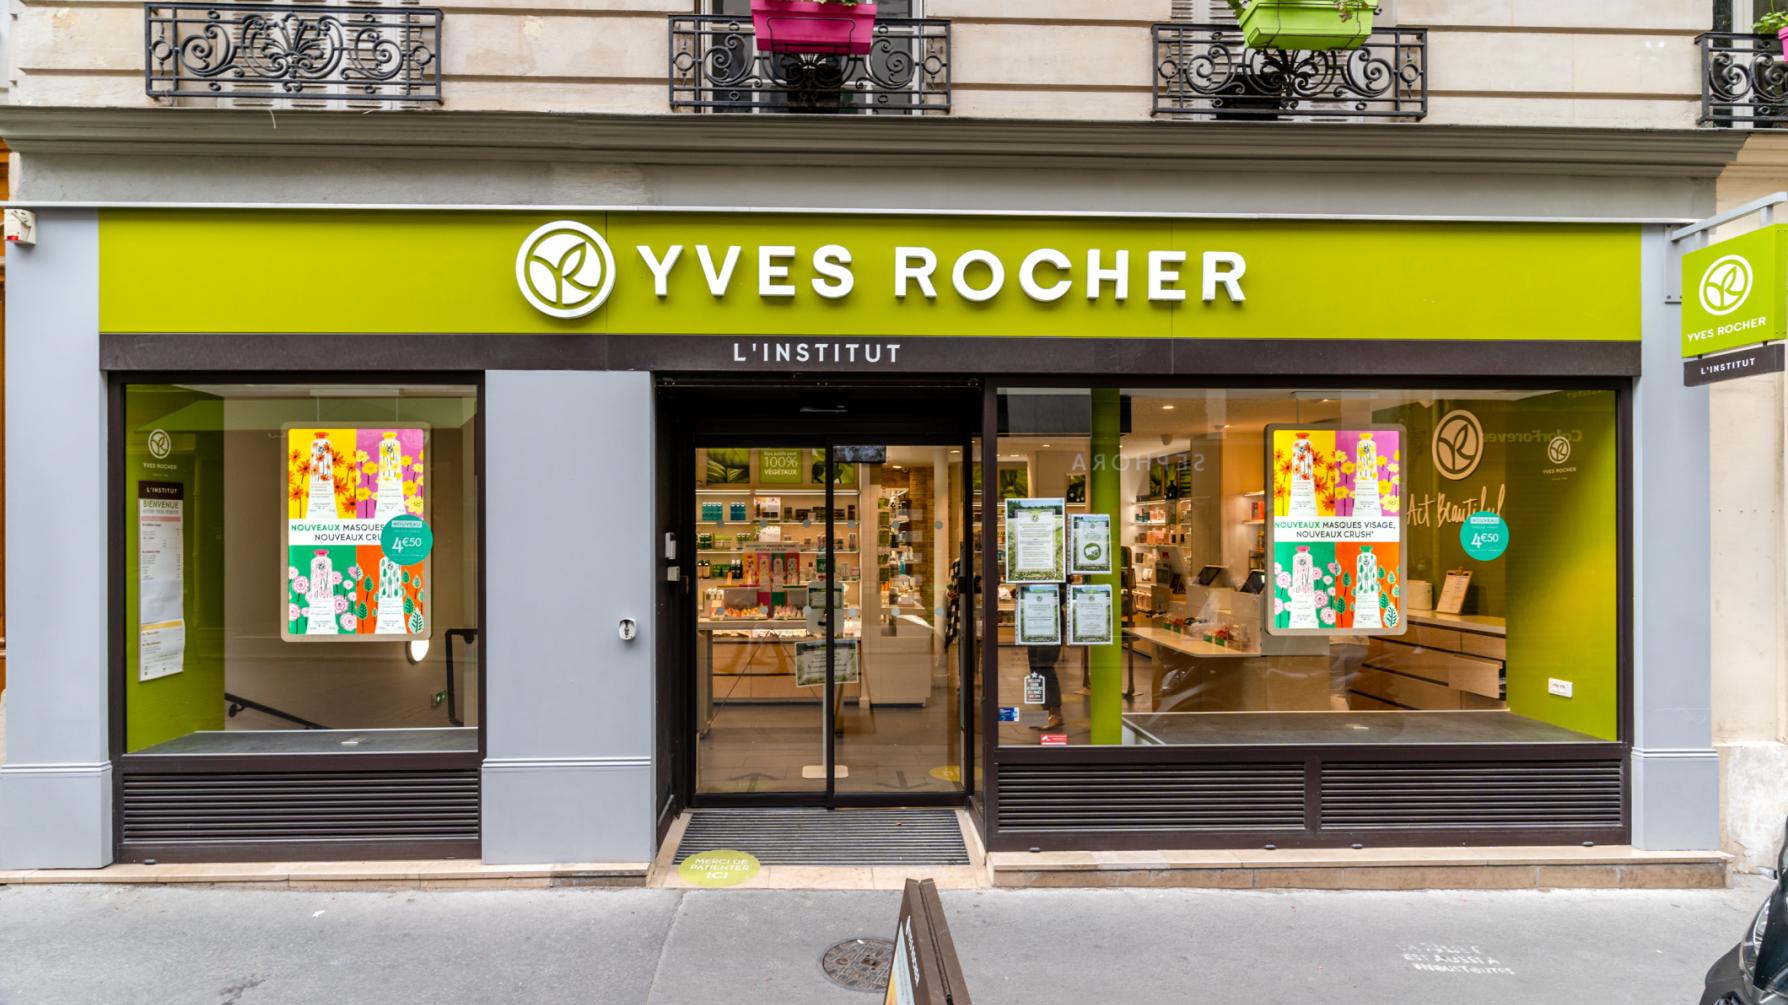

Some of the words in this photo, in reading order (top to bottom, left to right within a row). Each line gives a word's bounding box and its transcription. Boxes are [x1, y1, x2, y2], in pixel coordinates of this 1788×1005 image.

[636, 244, 855, 298] YVES
[893, 246, 1248, 304] ROCHER
[1687, 328, 1714, 342] YVES
[1717, 316, 1767, 335] ROCHER
[732, 342, 902, 364] L'INSTITUT
[1700, 358, 1756, 375] L'INSTITUT
[764, 456, 798, 468] 100%
[143, 501, 180, 509] BIENVENUE
[1406, 493, 1435, 527] Act
[343, 524, 385, 532] MASQUES
[1275, 521, 1320, 529] NOUVEAUX
[1322, 521, 1362, 529] MASQUES
[1364, 521, 1396, 530] VISAGE,
[314, 533, 363, 541] NOUVEAUX
[1296, 530, 1342, 538] NOUVEAUX
